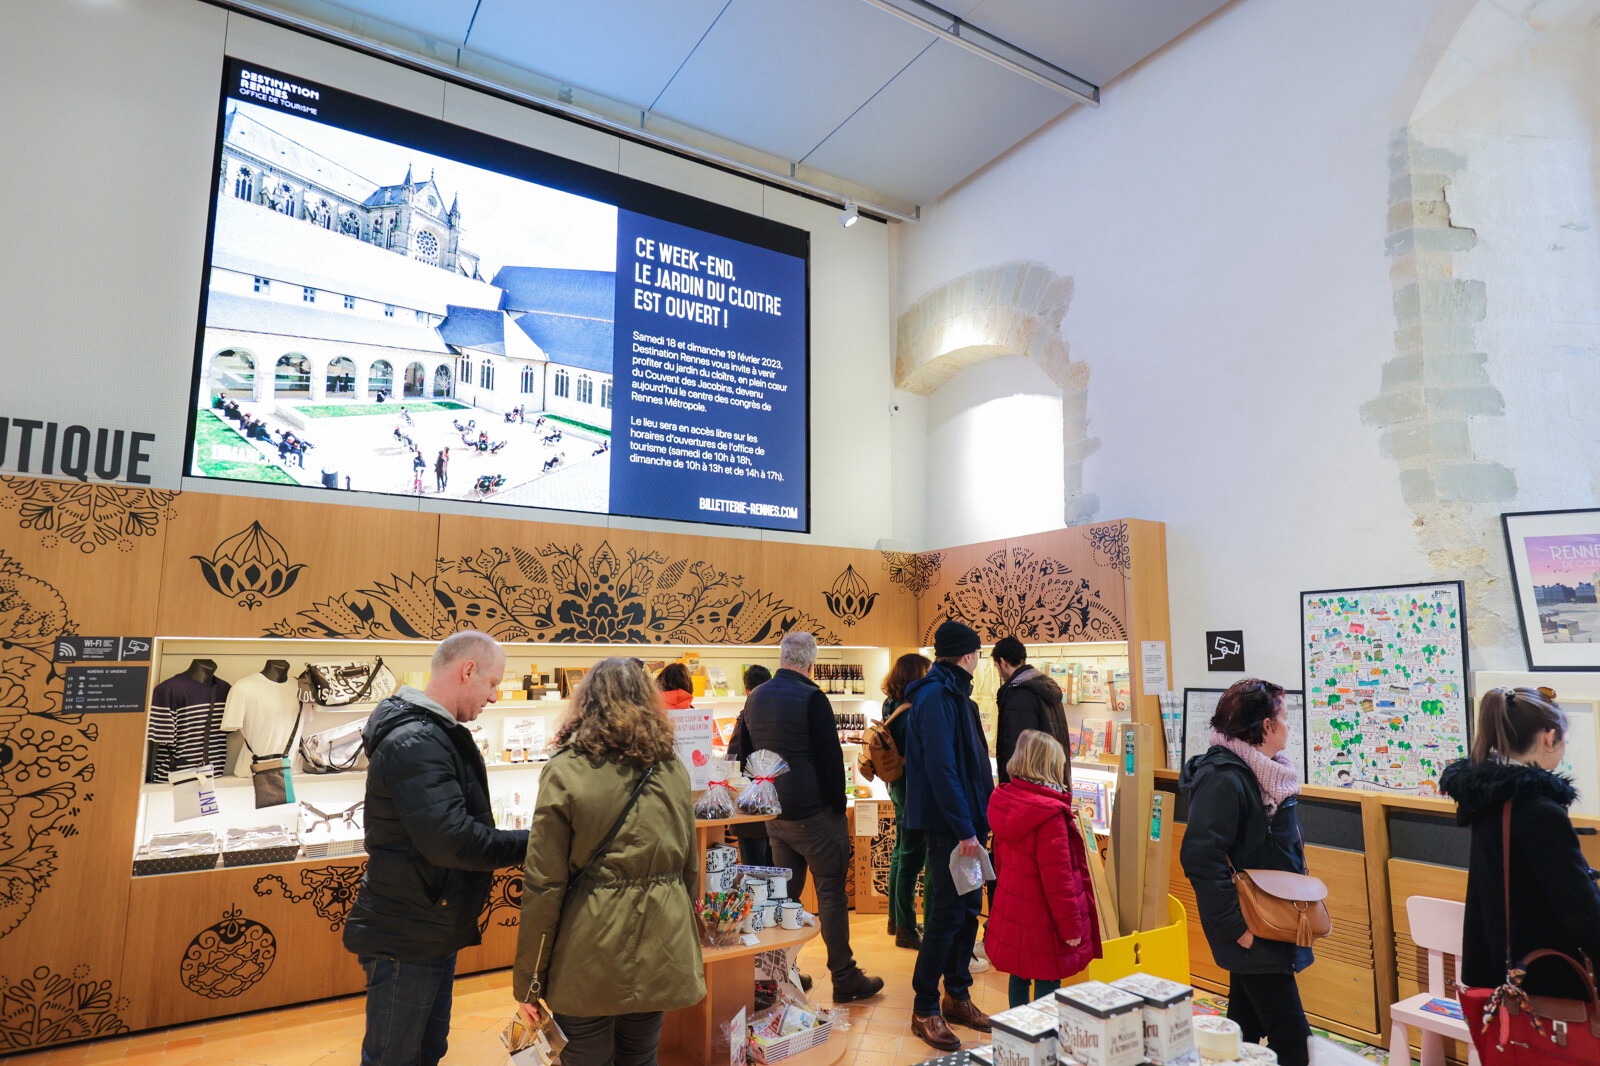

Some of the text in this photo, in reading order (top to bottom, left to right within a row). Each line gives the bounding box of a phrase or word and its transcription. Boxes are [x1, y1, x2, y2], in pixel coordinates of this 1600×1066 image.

[240, 79, 288, 100] RENNES
[241, 70, 320, 100] DESTINATION
[239, 88, 318, 115] OFFICE DE TOURISME
[636, 237, 736, 281] CE WEEK-END,
[635, 262, 782, 316] LE JARDIN DU CLOITRE
[634, 288, 661, 313] EST
[666, 296, 720, 326] OUVERT
[632, 343, 776, 378] Destination Rennes vous invite à venir
[633, 331, 783, 370] Samedi 18 et dimanche 19 février 2023,
[632, 356, 787, 392] profiter du jardin du cloître, en plein cœur
[632, 367, 764, 399] du Couvent des Jacobins, devenu
[631, 391, 707, 412] Rennes Métropole.
[632, 380, 772, 411] aujourd'hui le centre des congrès de
[630, 428, 664, 441] horaires
[717, 441, 727, 450] de
[755, 447, 765, 456] de
[631, 416, 642, 426] Le
[643, 417, 658, 428] lieu
[659, 422, 677, 431] sera
[679, 424, 689, 433] en
[691, 427, 714, 436] accès
[716, 428, 732, 439] libre
[747, 433, 758, 443] les
[630, 441, 752, 466] tourisme (samedi de 10h à 18h,
[630, 453, 784, 482] dimanche de 10h à 13h et de 14h à 17h).
[699, 497, 798, 519] BILLETTERIE-RENNES.COM
